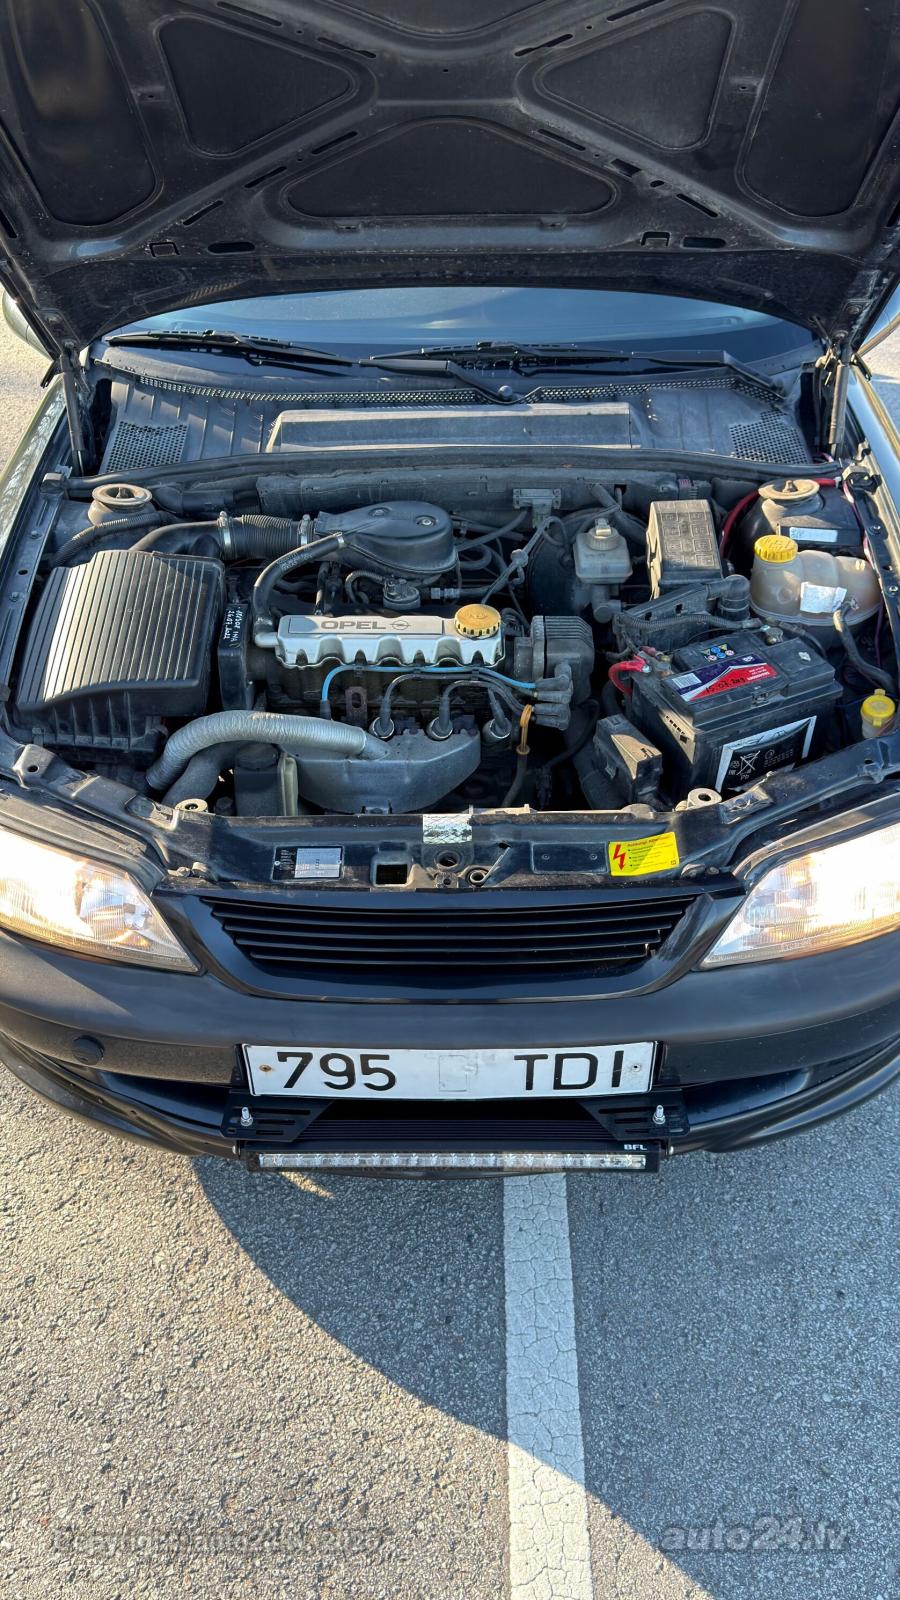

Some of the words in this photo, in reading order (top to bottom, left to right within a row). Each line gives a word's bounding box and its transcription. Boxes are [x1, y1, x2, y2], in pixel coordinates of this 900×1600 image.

[320, 620, 387, 630] OPEL
[276, 1051, 396, 1091] 795
[513, 1050, 625, 1091] TDI
[623, 1143, 648, 1151] BFL
